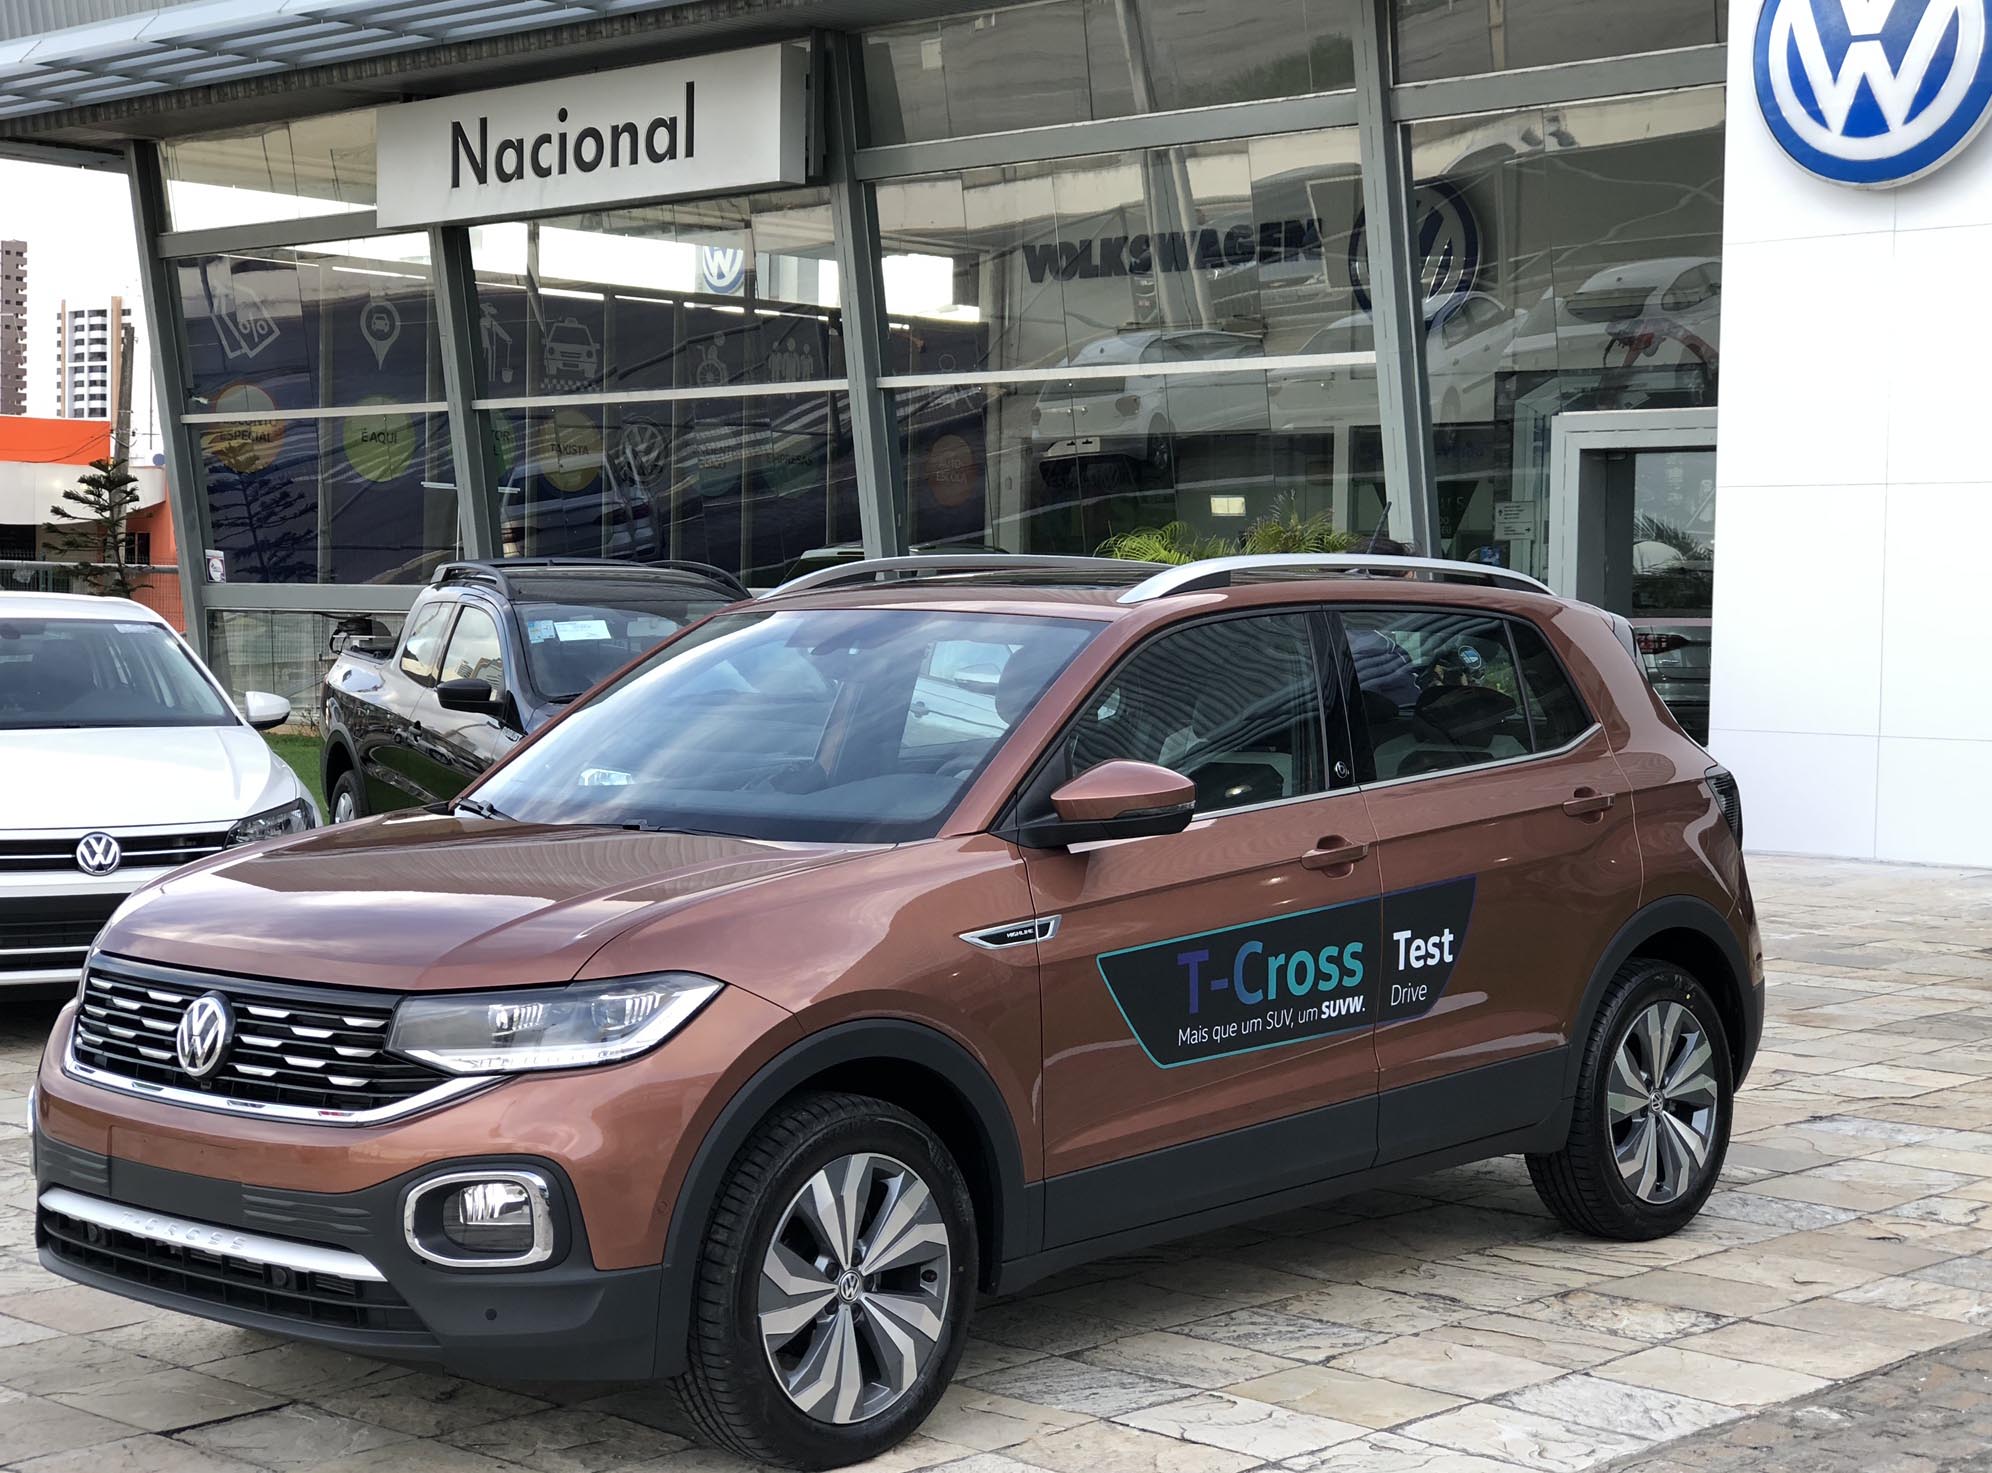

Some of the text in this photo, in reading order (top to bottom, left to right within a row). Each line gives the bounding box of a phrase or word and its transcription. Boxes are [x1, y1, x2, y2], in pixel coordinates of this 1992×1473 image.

[450, 80, 695, 189] Nacional
[1024, 217, 1324, 284] VOLKSWAGEN
[219, 430, 271, 443] ESPECIAL
[1393, 928, 1454, 971] Test
[1176, 940, 1364, 1016] T-Cross
[1390, 982, 1428, 1007] Drive
[1178, 995, 1366, 1046] Mais que um SUV, um SUVW.
